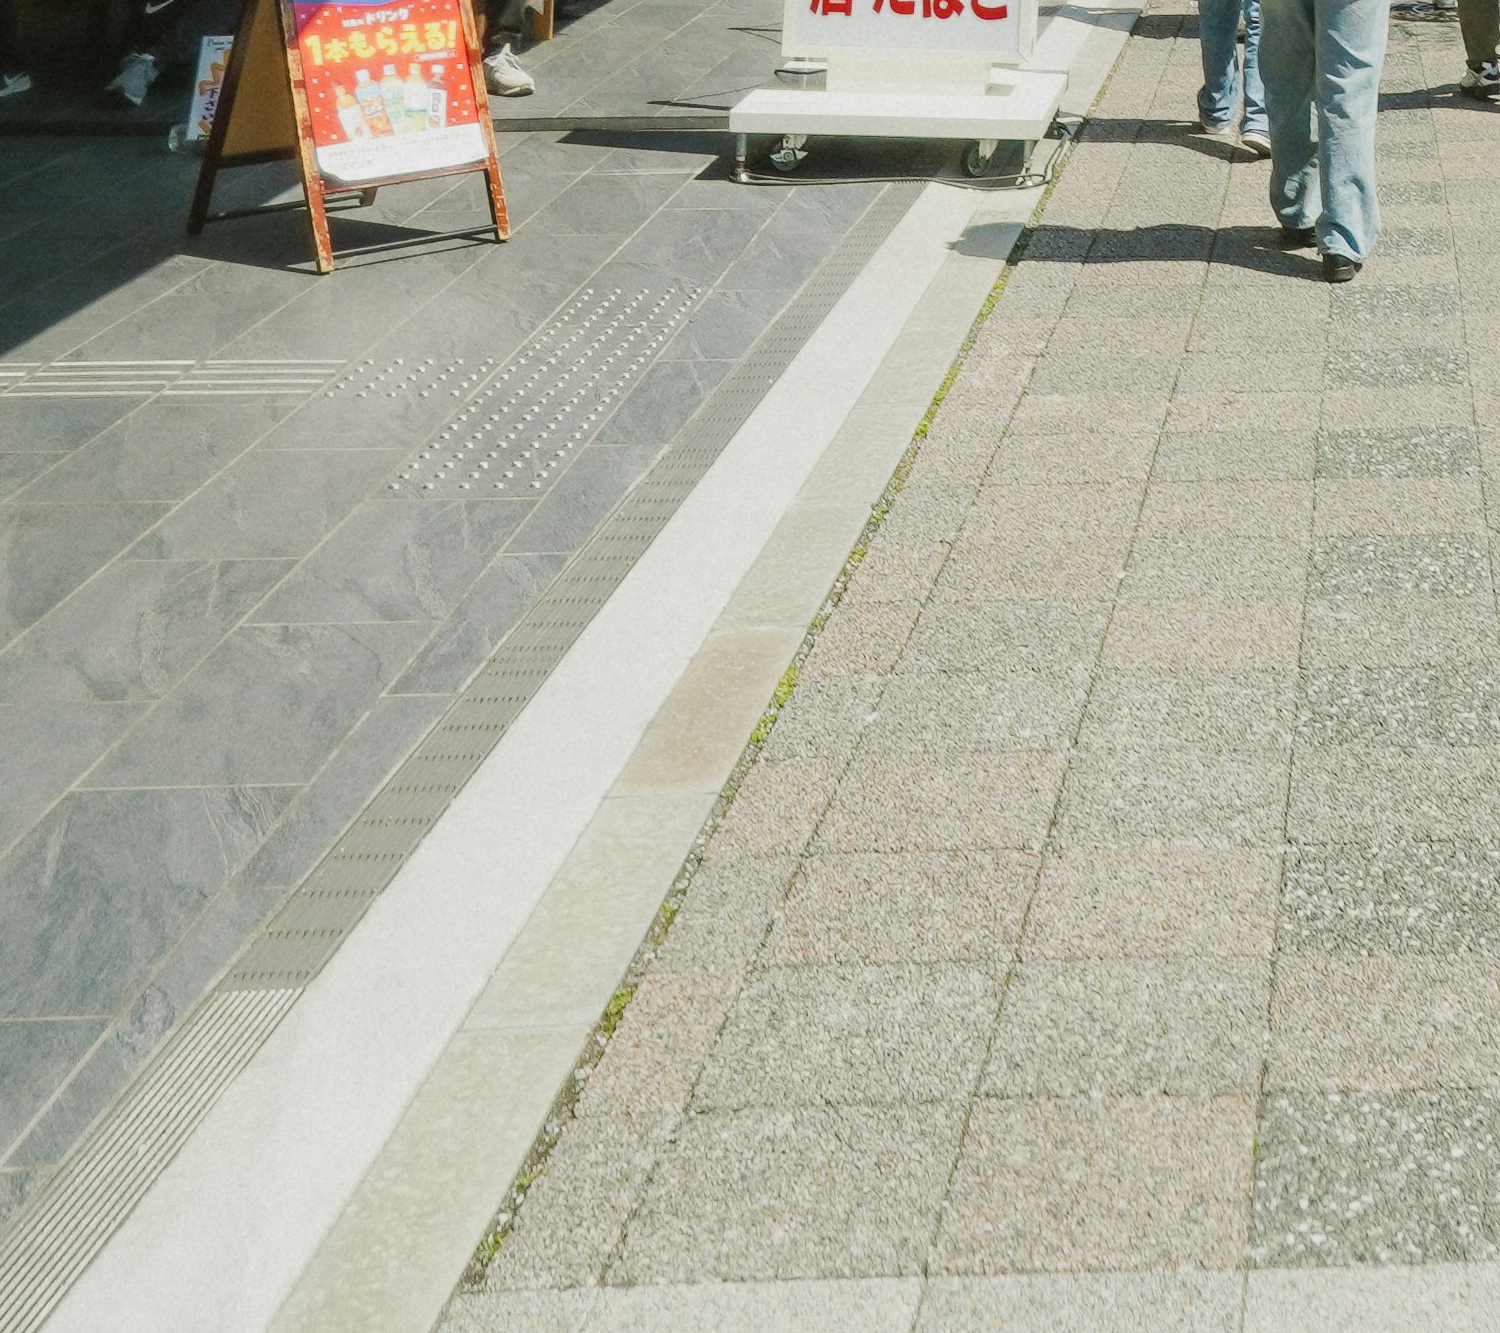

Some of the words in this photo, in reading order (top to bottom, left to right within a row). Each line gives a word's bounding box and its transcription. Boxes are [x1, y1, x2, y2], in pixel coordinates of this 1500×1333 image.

[304, 20, 458, 66] 1本もらえる!
